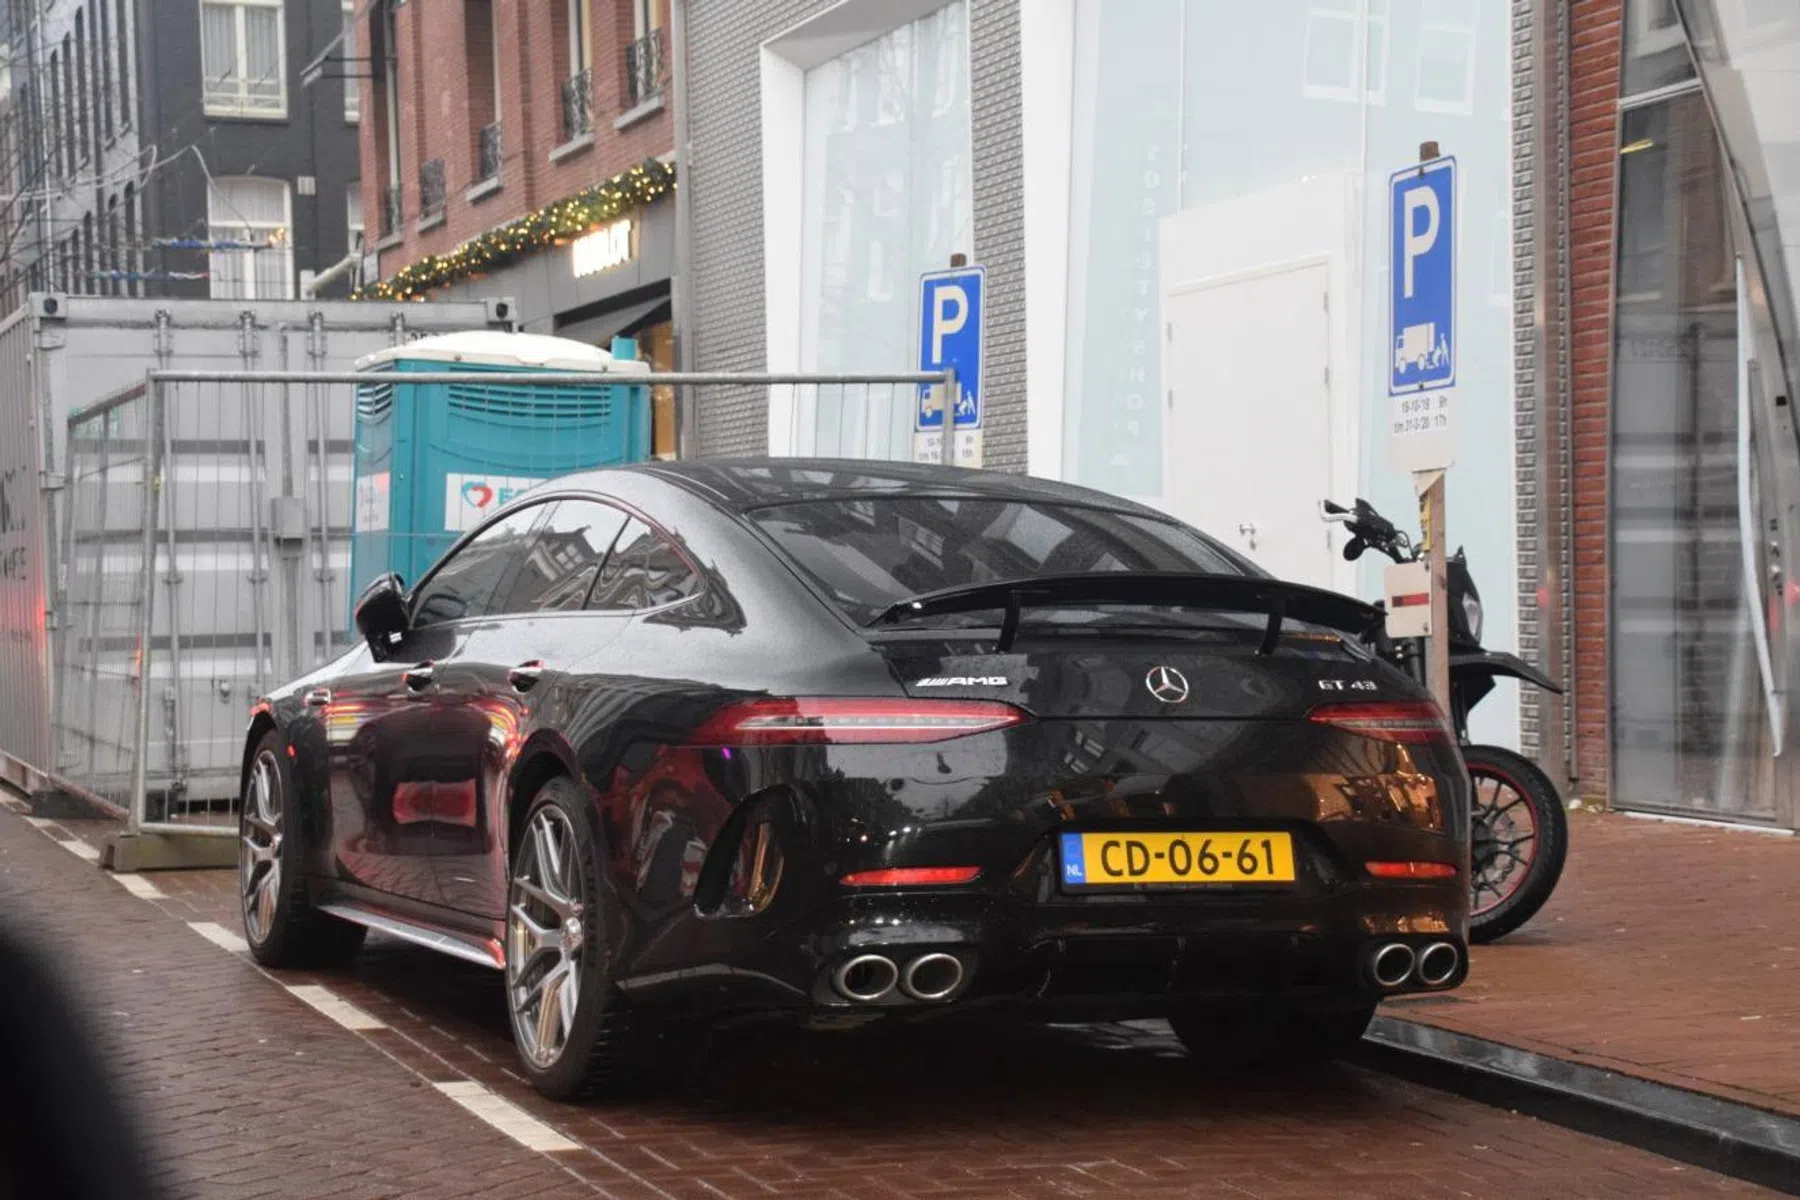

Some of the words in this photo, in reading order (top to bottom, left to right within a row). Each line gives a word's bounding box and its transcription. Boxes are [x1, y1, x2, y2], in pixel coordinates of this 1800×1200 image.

[1404, 185, 1440, 299] P
[931, 284, 969, 365] P
[946, 676, 1008, 686] AMG
[1318, 680, 1344, 690] GT
[1350, 680, 1378, 691] 43
[1066, 864, 1083, 877] NL
[1100, 838, 1274, 877] CD-06-61
